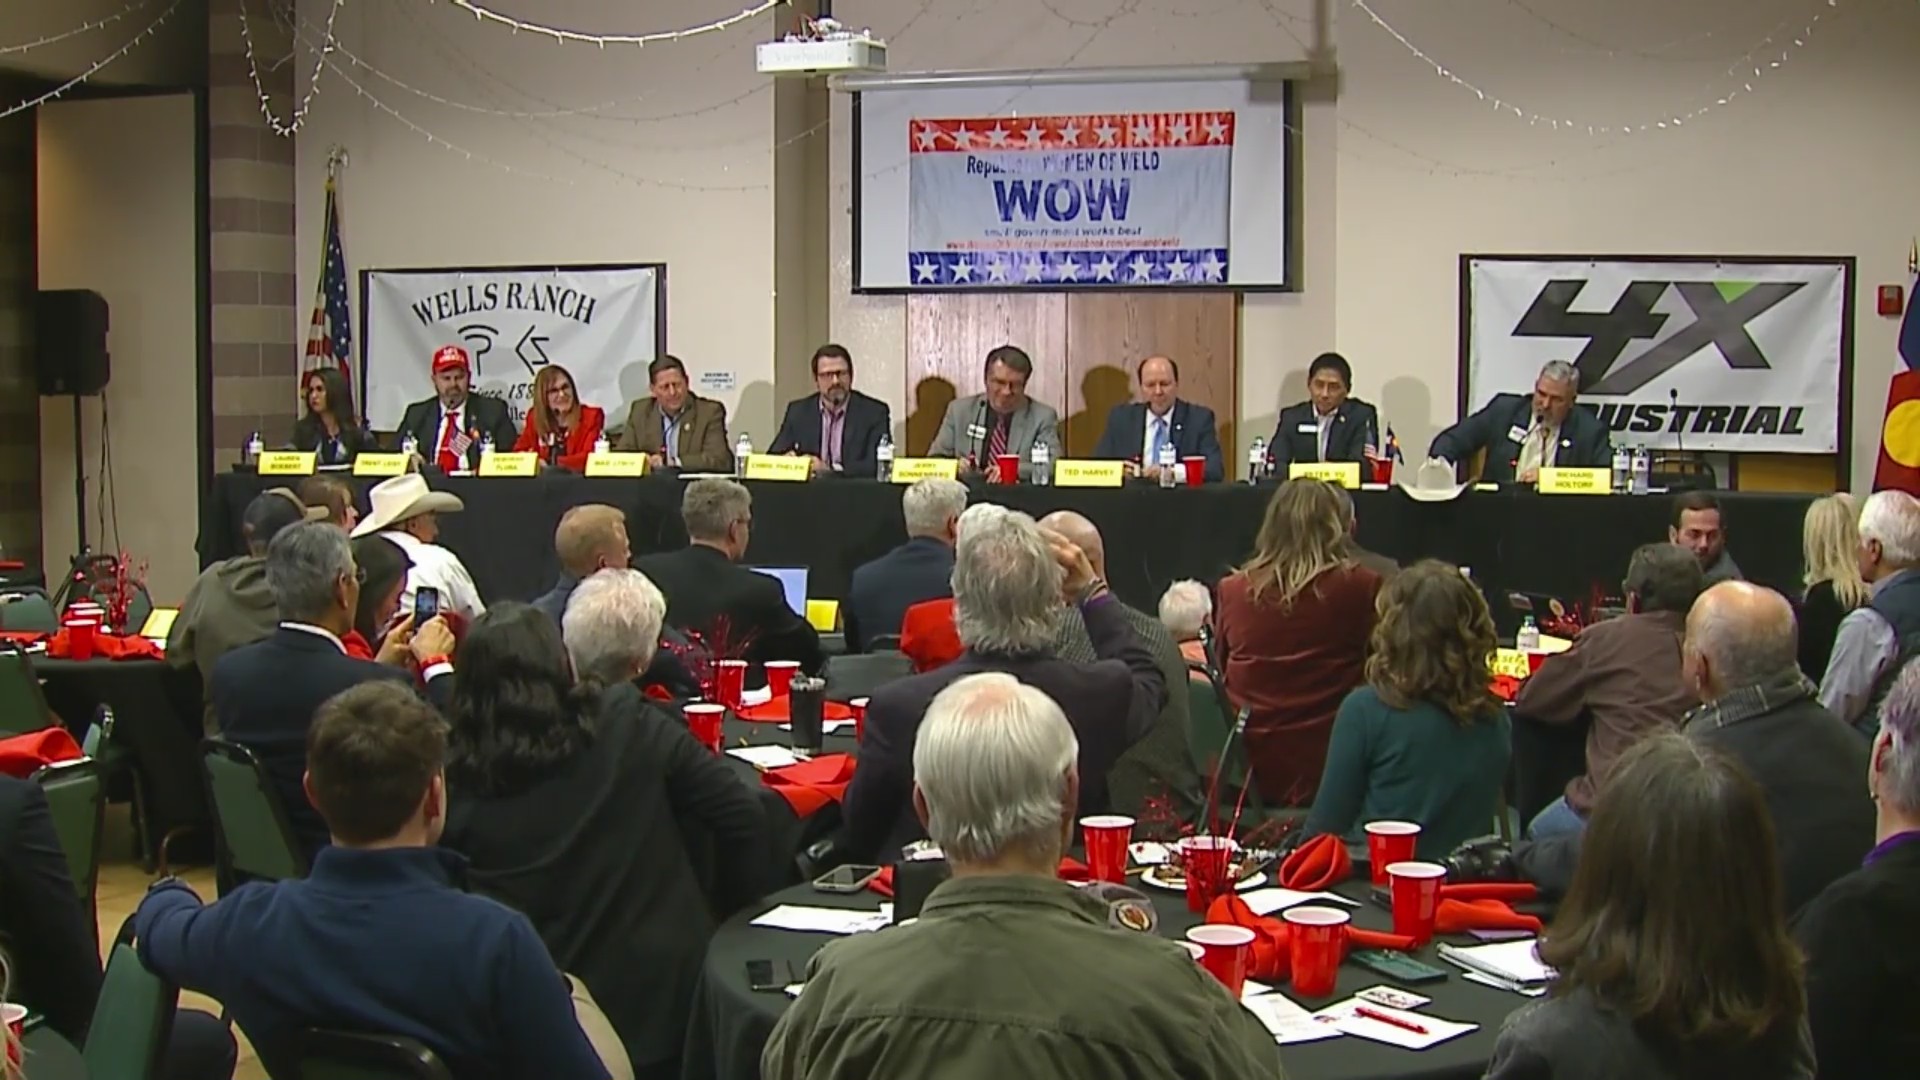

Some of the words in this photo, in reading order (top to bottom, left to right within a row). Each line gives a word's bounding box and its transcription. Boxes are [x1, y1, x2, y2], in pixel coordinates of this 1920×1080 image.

[1043, 152, 1094, 172] WMEN
[1099, 152, 1117, 171] OF
[1121, 151, 1160, 170] WELD
[993, 178, 1131, 222] WOW
[412, 283, 498, 326] WELLS
[506, 282, 596, 325] RANCH
[1511, 279, 1809, 396] 4X
[470, 384, 503, 399] ince
[508, 383, 535, 400] 188
[1575, 403, 1804, 434] USTRIAL
[1064, 468, 1079, 476] TED
[1082, 468, 1114, 476] HARVEY
[1556, 471, 1593, 479] RICHARD
[1555, 481, 1593, 489] HOLTORF
